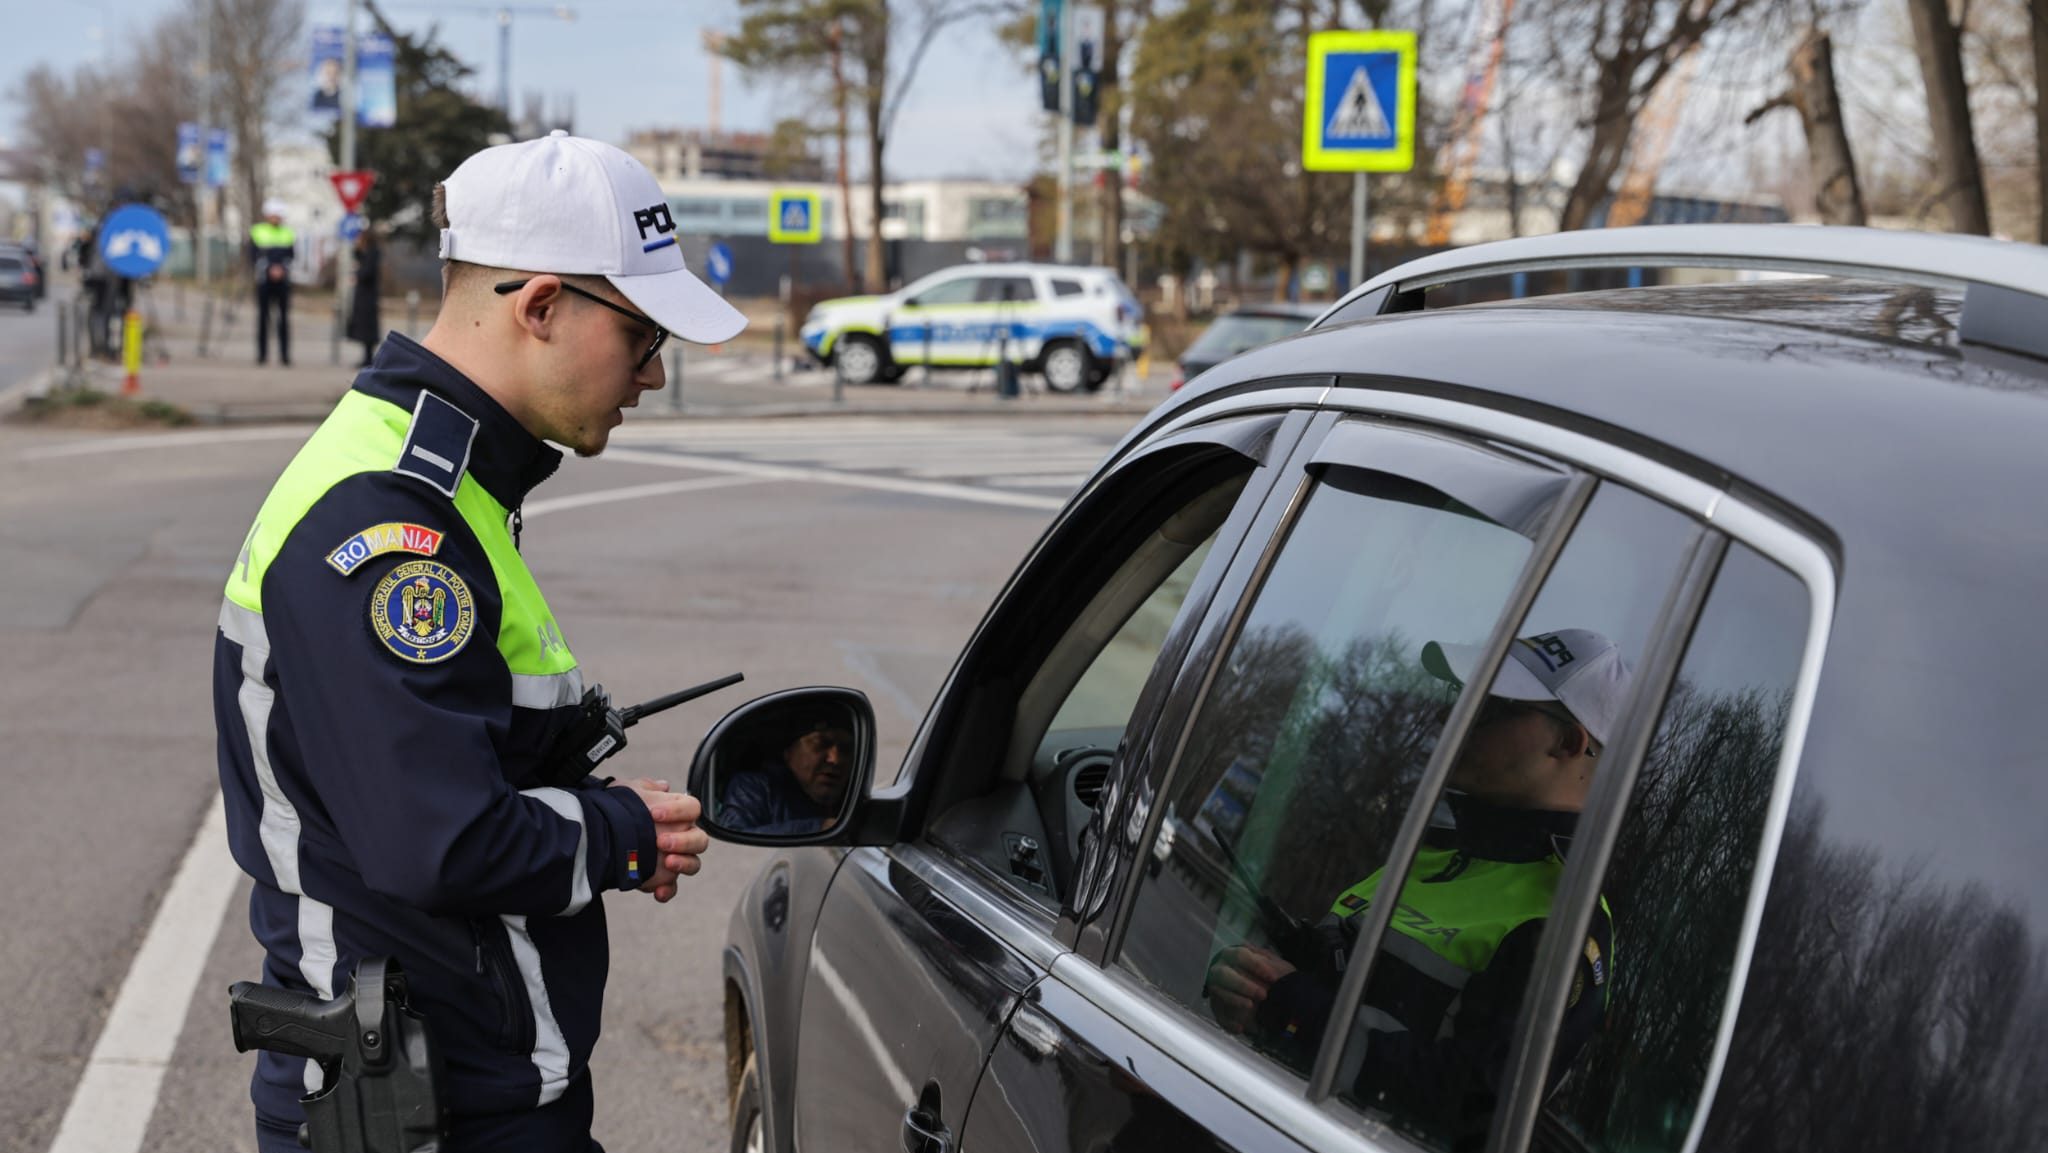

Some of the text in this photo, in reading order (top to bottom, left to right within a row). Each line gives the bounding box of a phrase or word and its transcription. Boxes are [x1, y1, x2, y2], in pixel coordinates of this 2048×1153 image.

[333, 527, 433, 570] ROMANIA
[375, 575, 397, 640] INSPECTORATUL
[396, 563, 435, 578] GENERAL
[436, 567, 448, 580] AL
